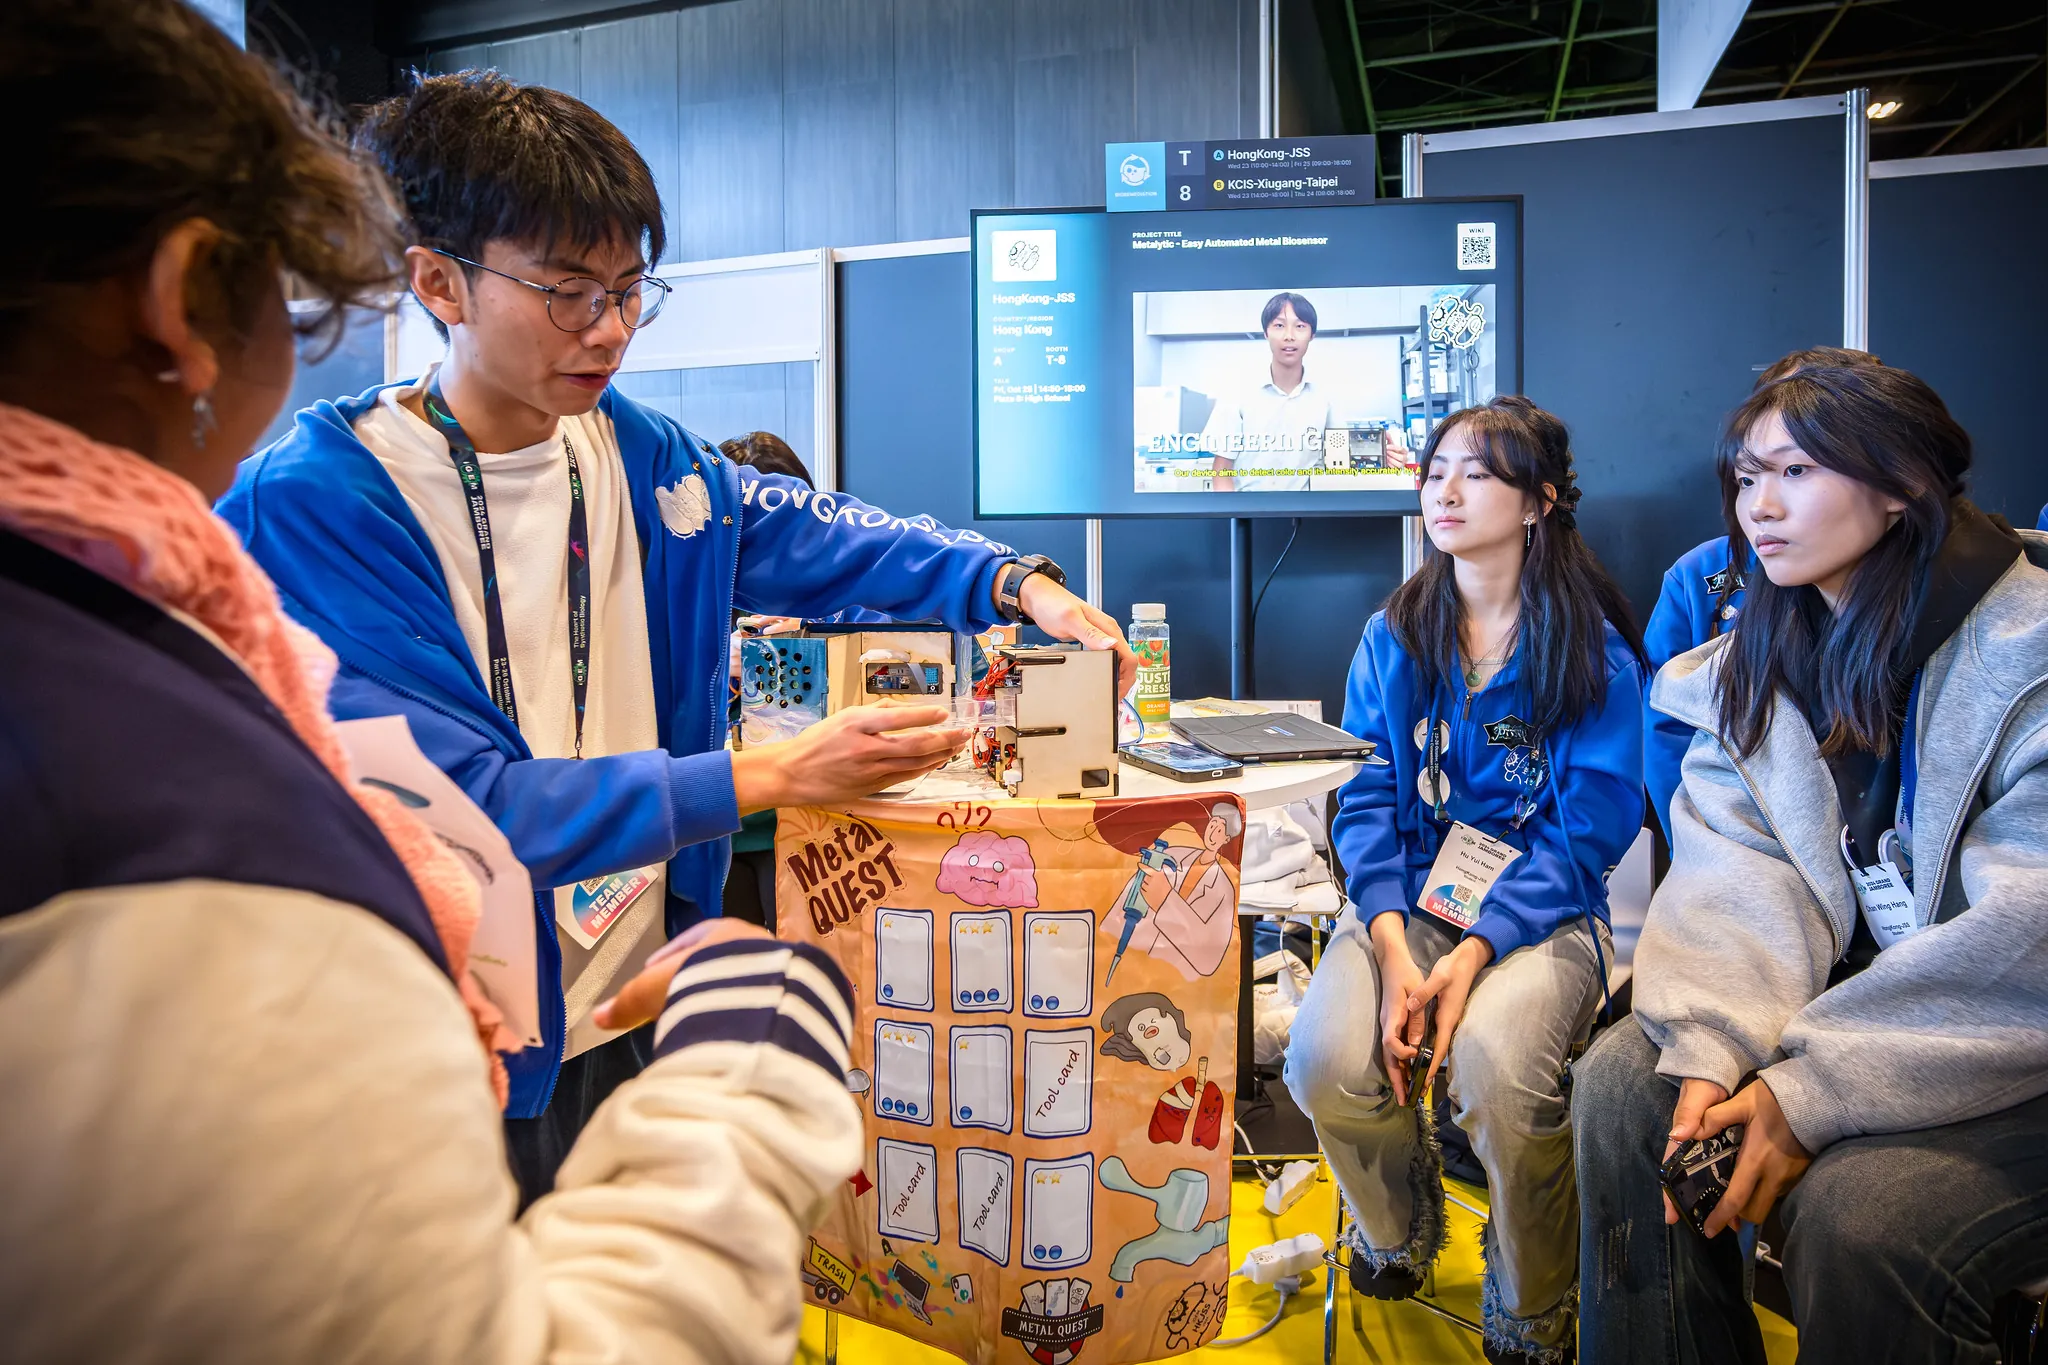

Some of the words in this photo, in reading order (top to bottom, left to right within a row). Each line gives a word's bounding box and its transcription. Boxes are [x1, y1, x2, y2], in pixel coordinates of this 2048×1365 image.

[1178, 150, 1192, 166] T
[1228, 147, 1311, 161] HongKong-JSS
[1179, 185, 1191, 202] 8
[1228, 176, 1339, 191] KCIS-Xiugang-Taipei
[1133, 240, 1175, 250] Metalytic
[1181, 239, 1204, 249] Easy
[1204, 238, 1254, 248] Automated
[1256, 237, 1281, 246] Metal
[1282, 236, 1329, 246] Biosensor
[992, 293, 1076, 306] HongKong-JSS
[993, 325, 1022, 337] Hong
[1024, 325, 1053, 337] Kong
[993, 356, 1002, 366] A
[1174, 469, 1191, 477] Our
[1192, 469, 1217, 477] device
[1219, 469, 1238, 477] aims
[1249, 468, 1275, 476] detect
[1276, 468, 1296, 476] color
[1298, 468, 1312, 476] and
[1314, 467, 1323, 475] its
[1325, 467, 1359, 477] intensity
[1361, 466, 1402, 476] accurately
[1403, 466, 1414, 476] by
[476, 495, 486, 516] 2024
[470, 496, 488, 551] JAMBOREE
[787, 813, 884, 893] Metal
[588, 877, 624, 912] TEAM
[807, 842, 903, 936] QUEST
[589, 876, 642, 929] MEMBER
[1443, 897, 1473, 918] TEAM
[1057, 1048, 1080, 1086] card
[907, 1161, 927, 1194] card
[987, 1171, 1005, 1206] card
[817, 1252, 848, 1286] TRASH
[1019, 1320, 1055, 1337] METAL
[1057, 1317, 1090, 1338] QUEST
[1192, 1303, 1211, 1333] HKJSS
